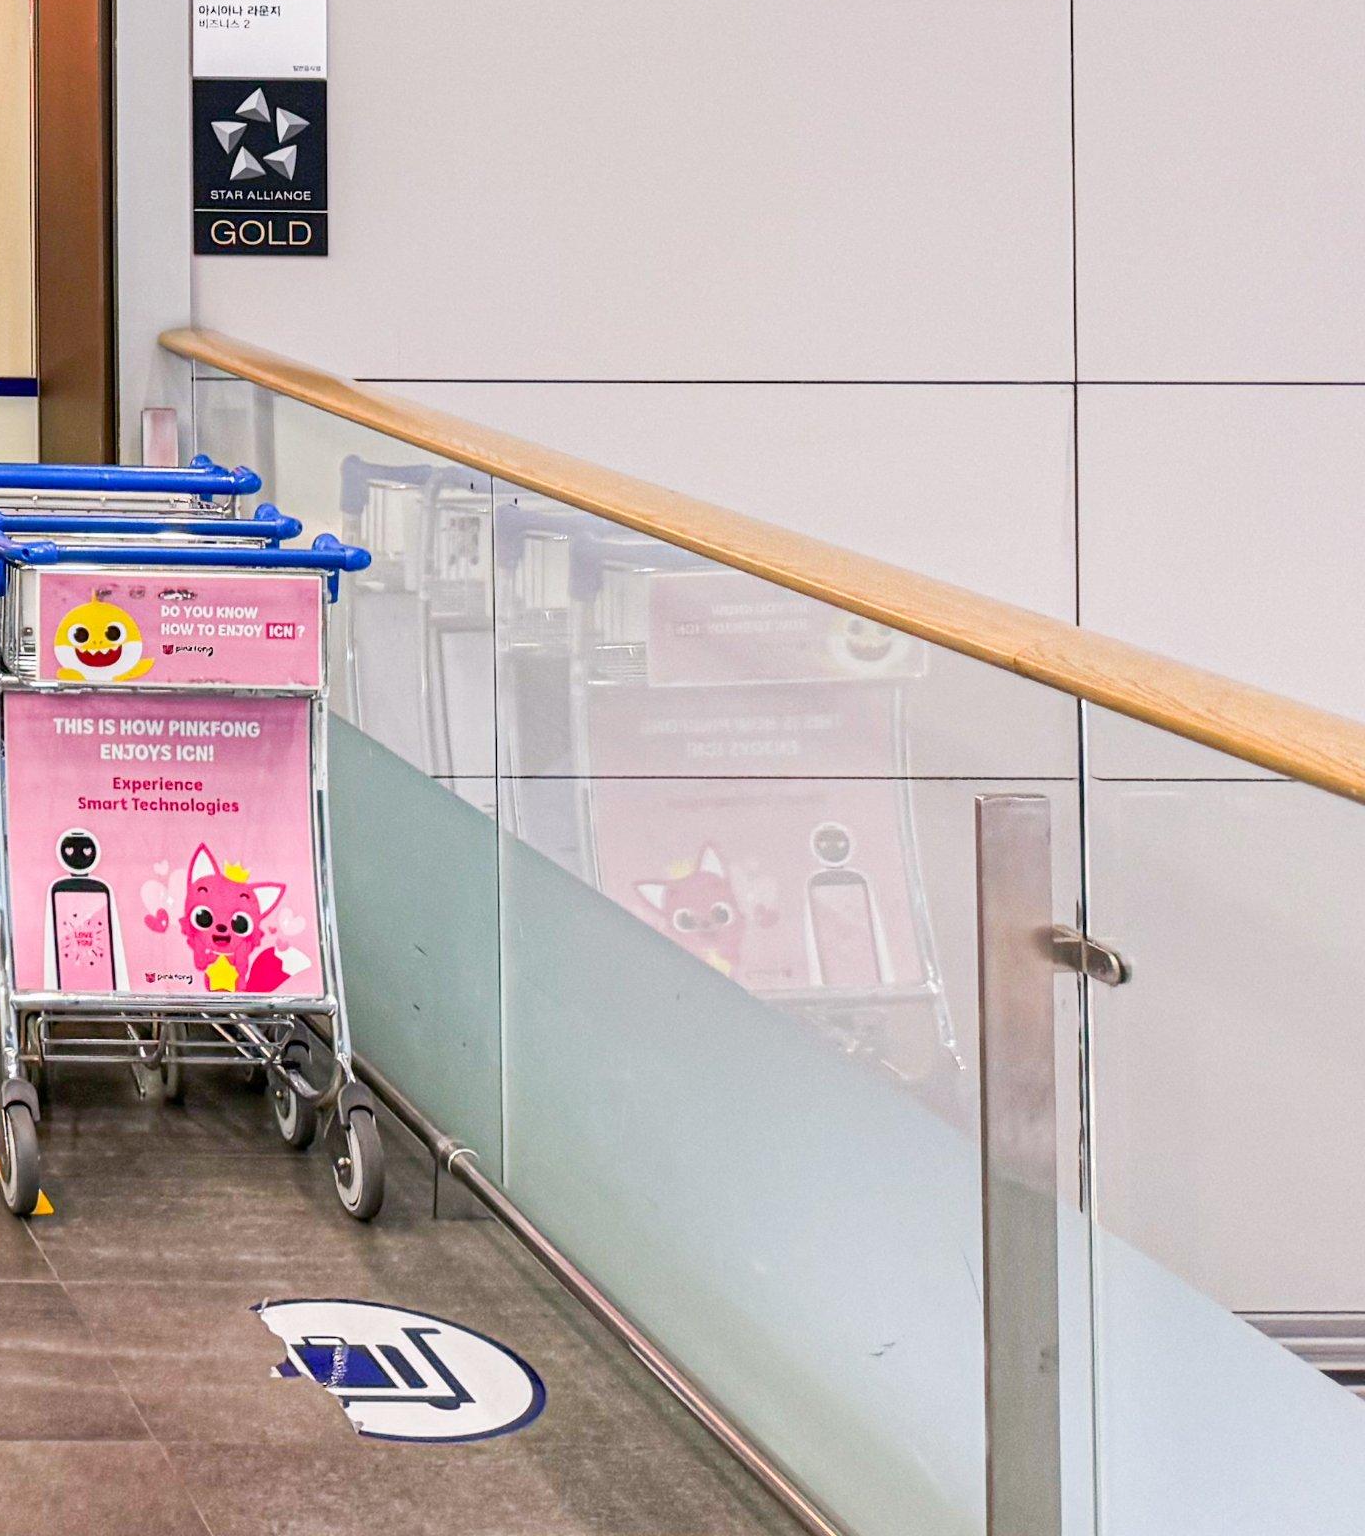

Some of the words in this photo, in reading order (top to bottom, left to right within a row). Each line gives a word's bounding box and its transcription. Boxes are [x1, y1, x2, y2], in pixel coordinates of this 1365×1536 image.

[198, 4, 243, 16] 아시아나
[247, 5, 282, 17] 라운지
[198, 18, 240, 29] 비즈니스
[244, 19, 251, 29] 2
[210, 189, 243, 200] STAR
[247, 190, 312, 201] ALLIANCE
[210, 219, 312, 245] GOLD
[161, 605, 180, 617] DO
[183, 606, 214, 618] YOU
[216, 606, 258, 619] KNOW
[161, 623, 194, 636] HOW
[197, 623, 215, 636] TO
[218, 624, 263, 638] ENJOY
[269, 624, 293, 637] ICN
[53, 717, 94, 735] THIS
[98, 718, 115, 735] IS
[120, 719, 164, 736] HOW
[169, 720, 261, 738] PINKFONG
[100, 743, 171, 761] ENJOYS
[176, 745, 214, 762] ICN!
[112, 776, 203, 794] Experience
[78, 797, 127, 811] Smart
[131, 798, 240, 816] Technologies
